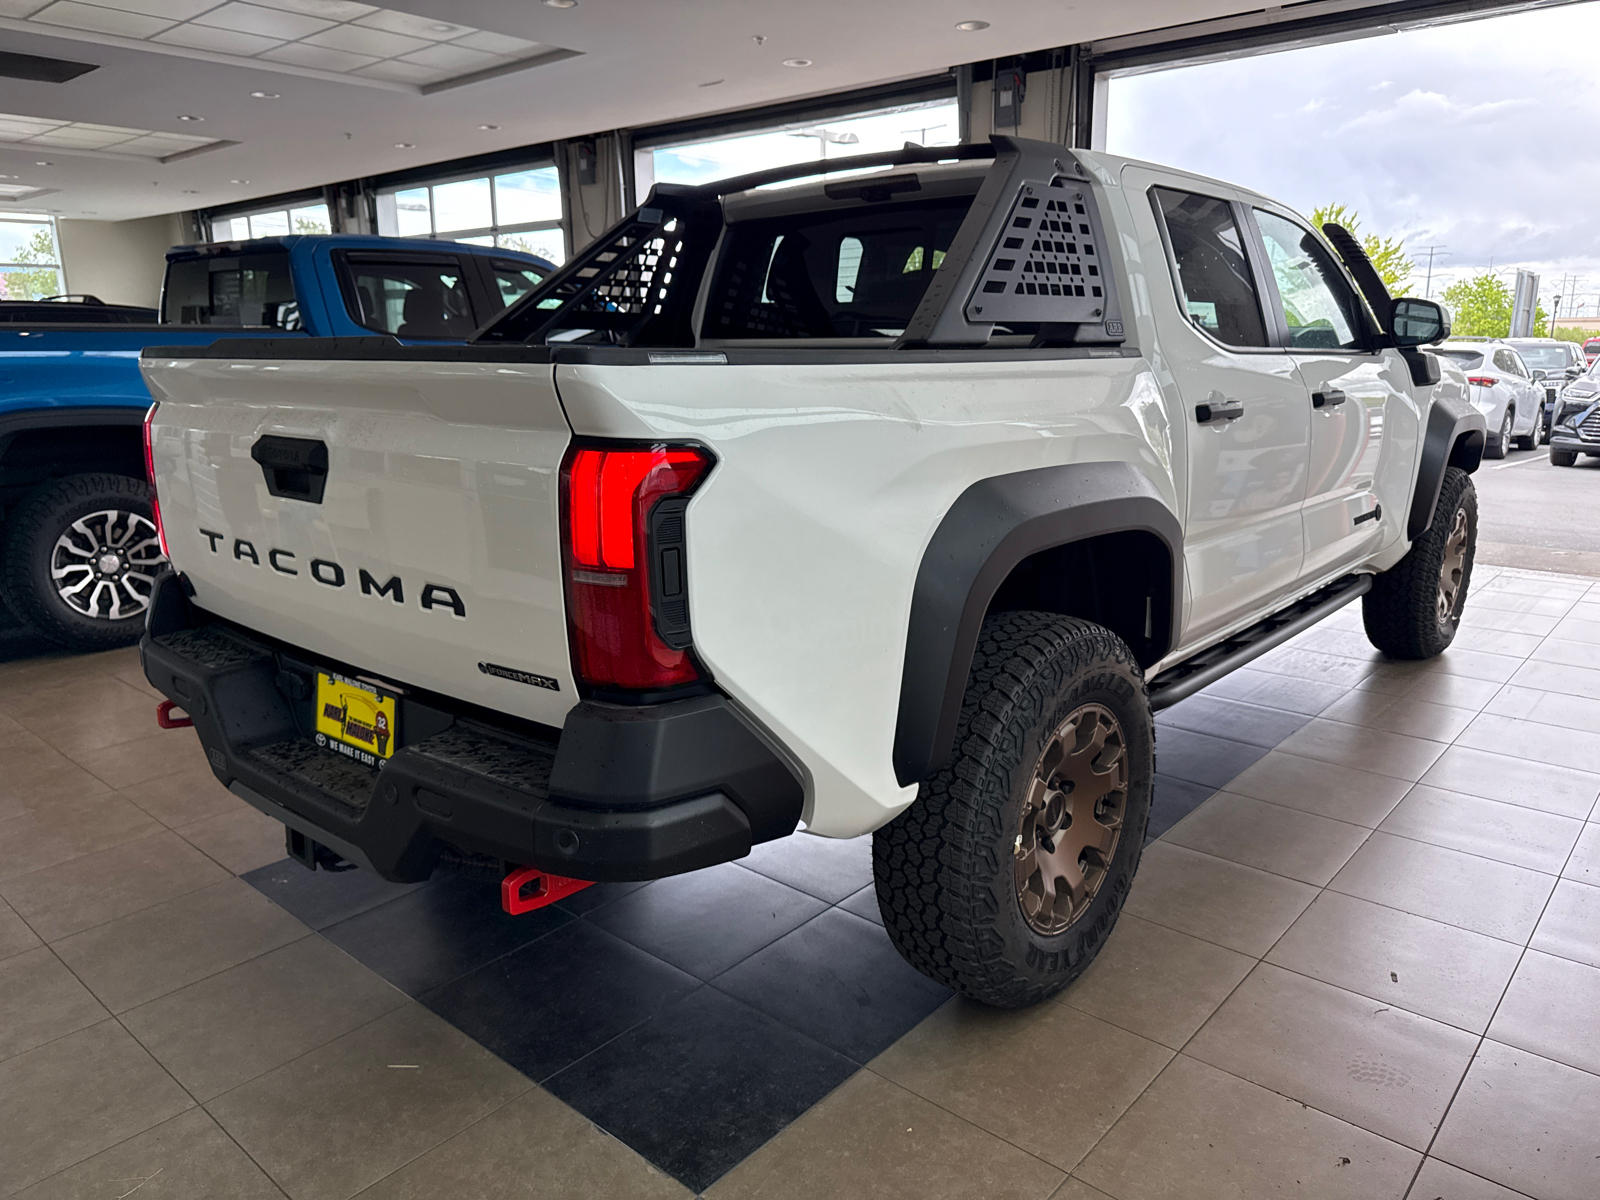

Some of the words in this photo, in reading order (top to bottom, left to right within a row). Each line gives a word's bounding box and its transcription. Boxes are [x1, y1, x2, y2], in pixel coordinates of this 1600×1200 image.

[199, 528, 466, 617] TACOMA
[346, 720, 375, 745] MALONE
[329, 739, 339, 750] WE
[339, 741, 354, 757] MAKE
[354, 748, 360, 760] IT
[361, 752, 375, 766] EASY
